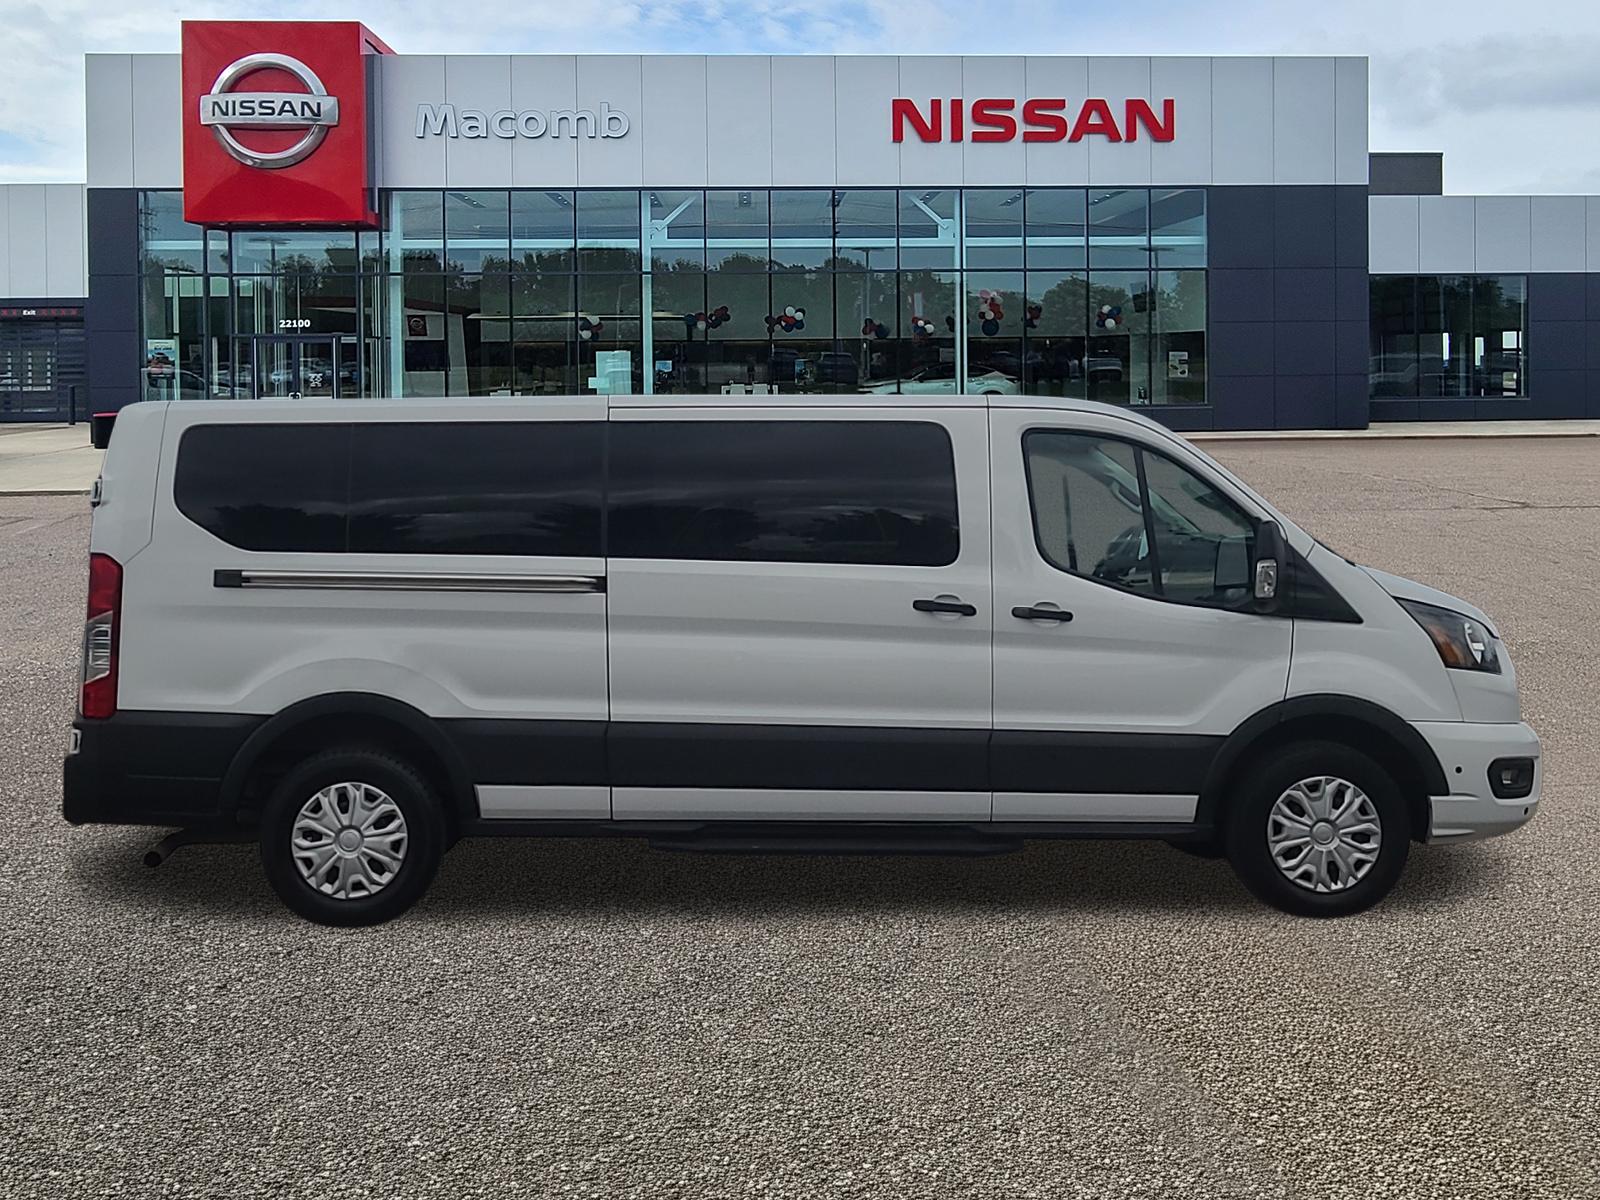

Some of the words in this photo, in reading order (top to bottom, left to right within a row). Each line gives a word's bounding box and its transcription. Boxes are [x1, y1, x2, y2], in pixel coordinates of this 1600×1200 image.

[212, 100, 322, 117] NISSAN
[415, 102, 630, 138] Macomb
[892, 98, 1175, 142] NISSAN
[279, 319, 311, 328] 22100
